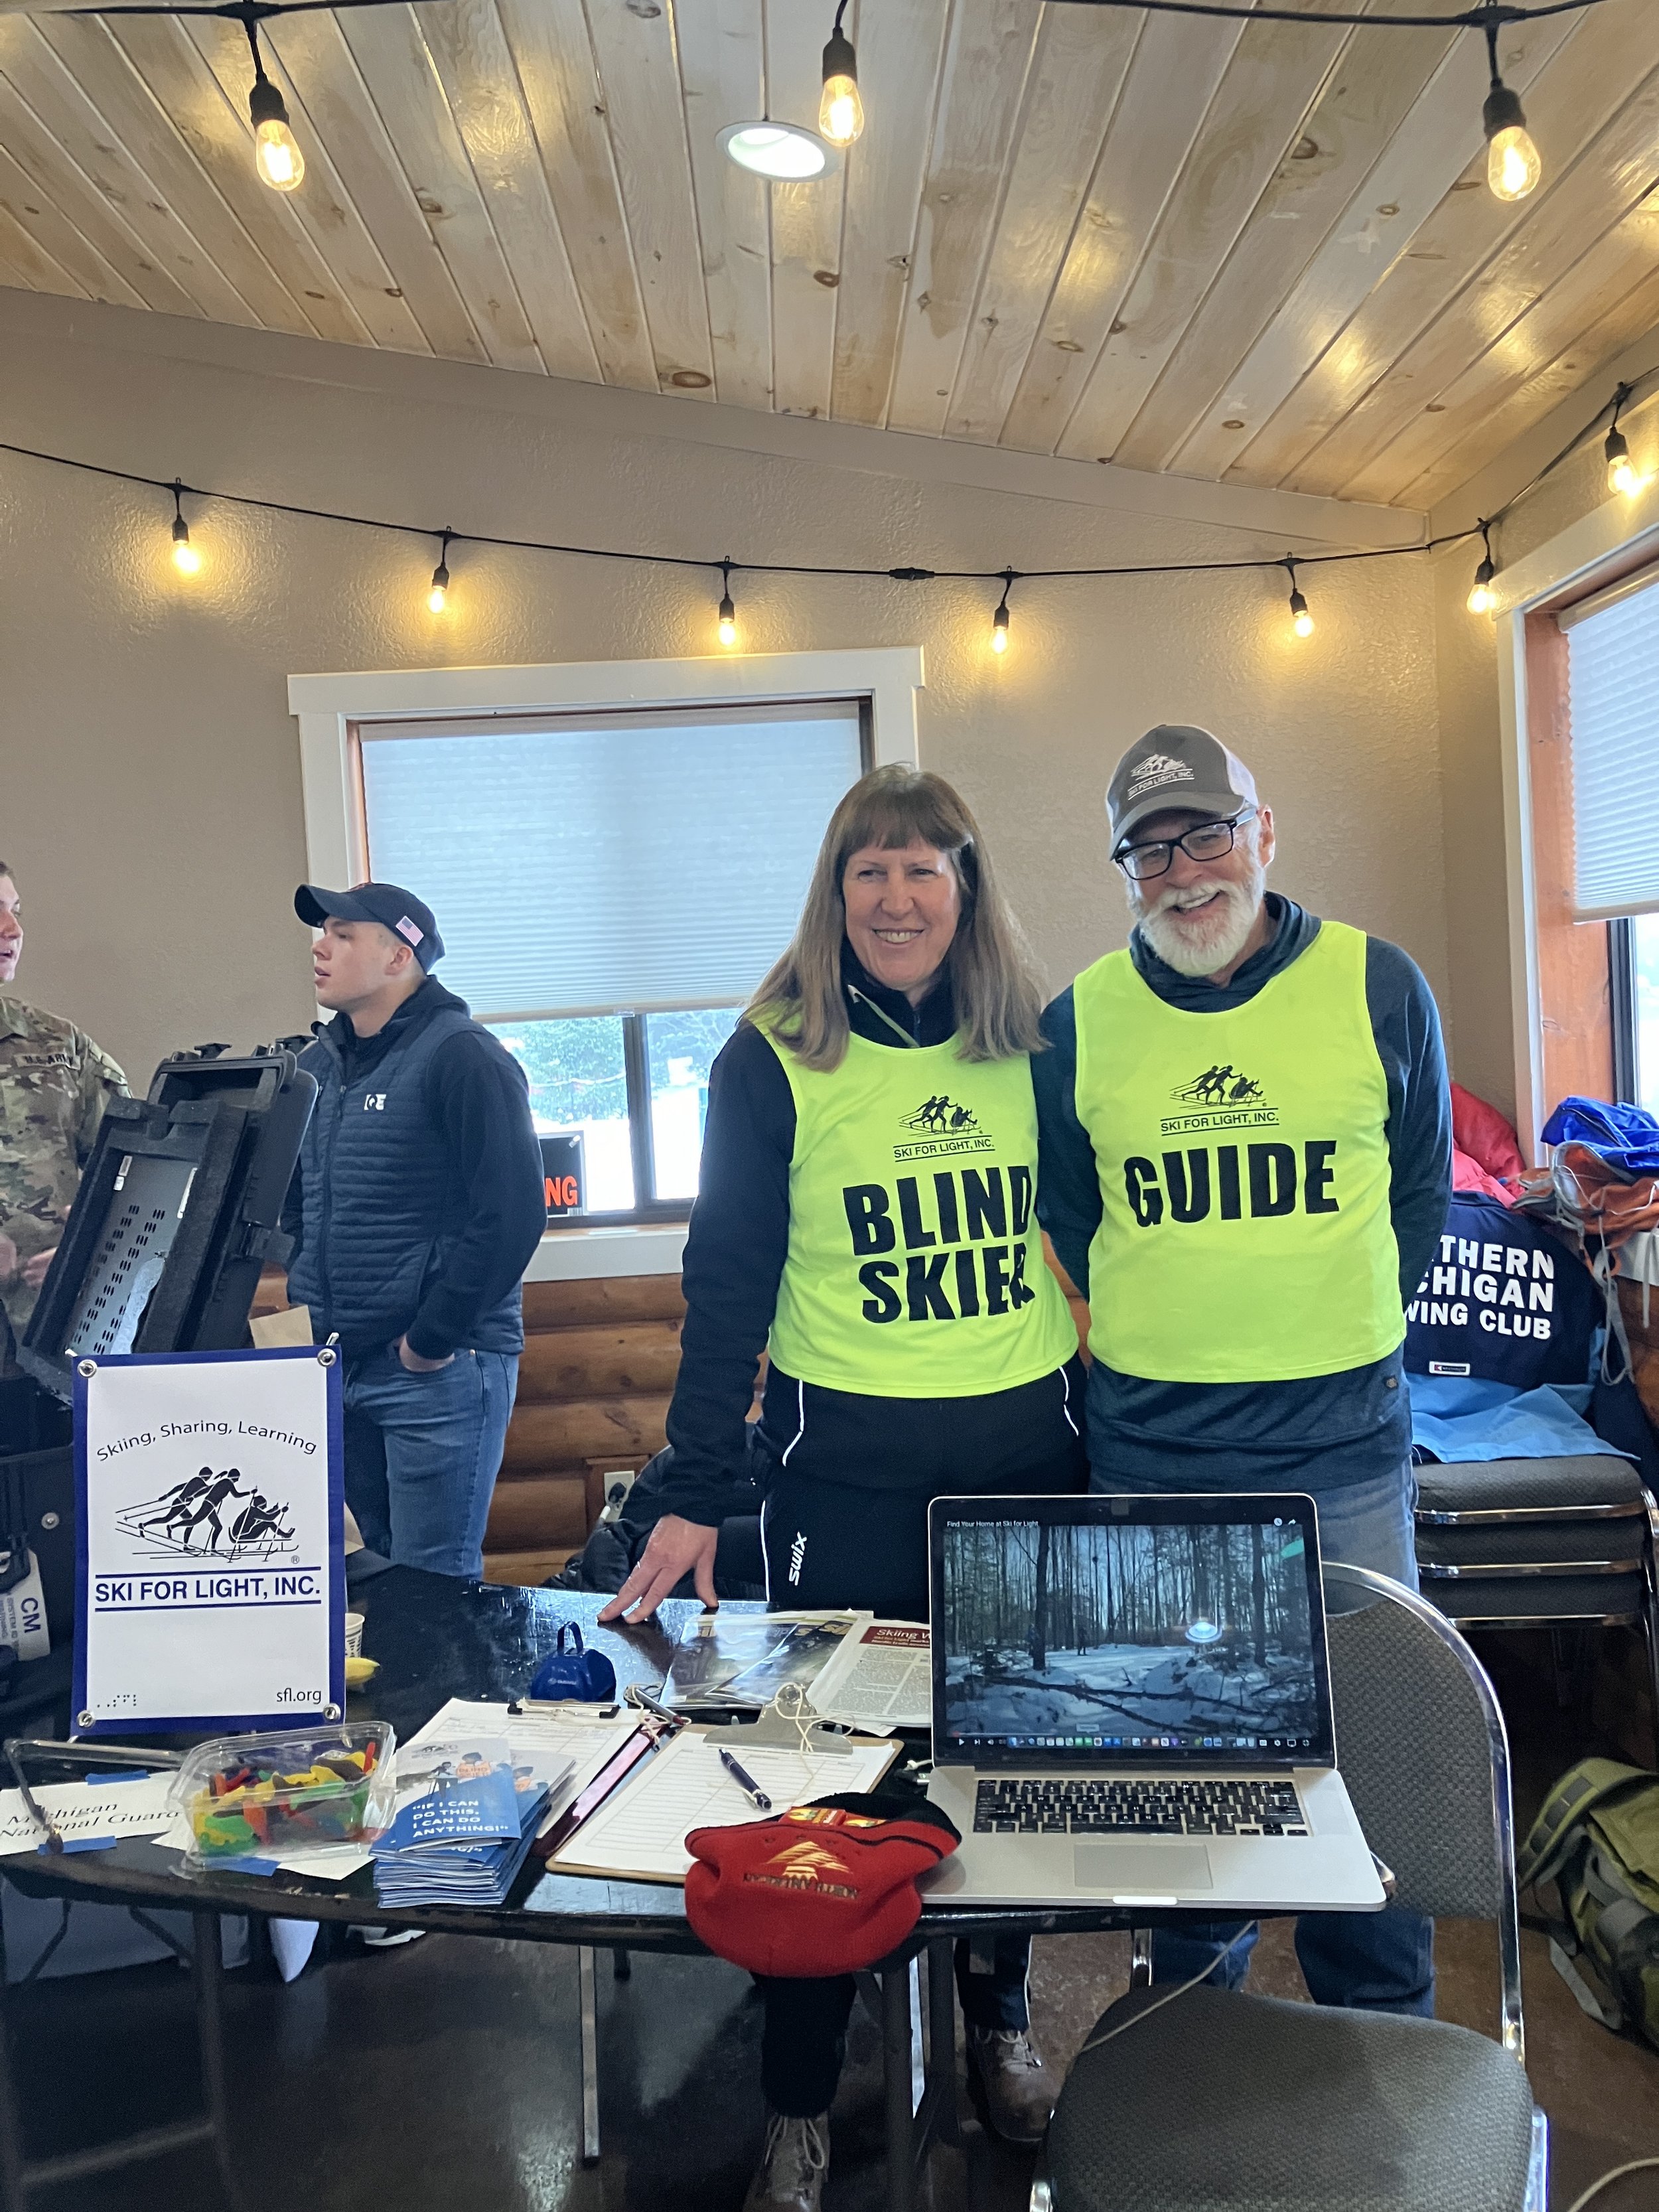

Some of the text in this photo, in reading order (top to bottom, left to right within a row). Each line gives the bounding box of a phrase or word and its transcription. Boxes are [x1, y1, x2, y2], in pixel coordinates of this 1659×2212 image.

[1139, 780, 1153, 790] FOR
[1154, 773, 1178, 784] LIGHT,
[1161, 1111, 1279, 1132] SKI FOR LIGHT, INC.
[894, 1138, 994, 1158] SKI FOR LIGHT, INC.
[1124, 1140, 1339, 1227] GUIDE
[843, 1165, 1032, 1256] BLIND
[1433, 1234, 1554, 1280] THERN
[859, 1242, 1035, 1323] SKIER
[1479, 1309, 1551, 1340] CLUB
[97, 1420, 317, 1461] Skiing, Sharing, Learning
[96, 1576, 321, 1602] SKI FOR LIGHT, INC.
[21, 1597, 41, 1633] CM
[877, 1629, 918, 1640] Skiing
[276, 1688, 322, 1705] sfl.org
[413, 1811, 435, 1820] DO
[422, 1818, 453, 1826] CAN
